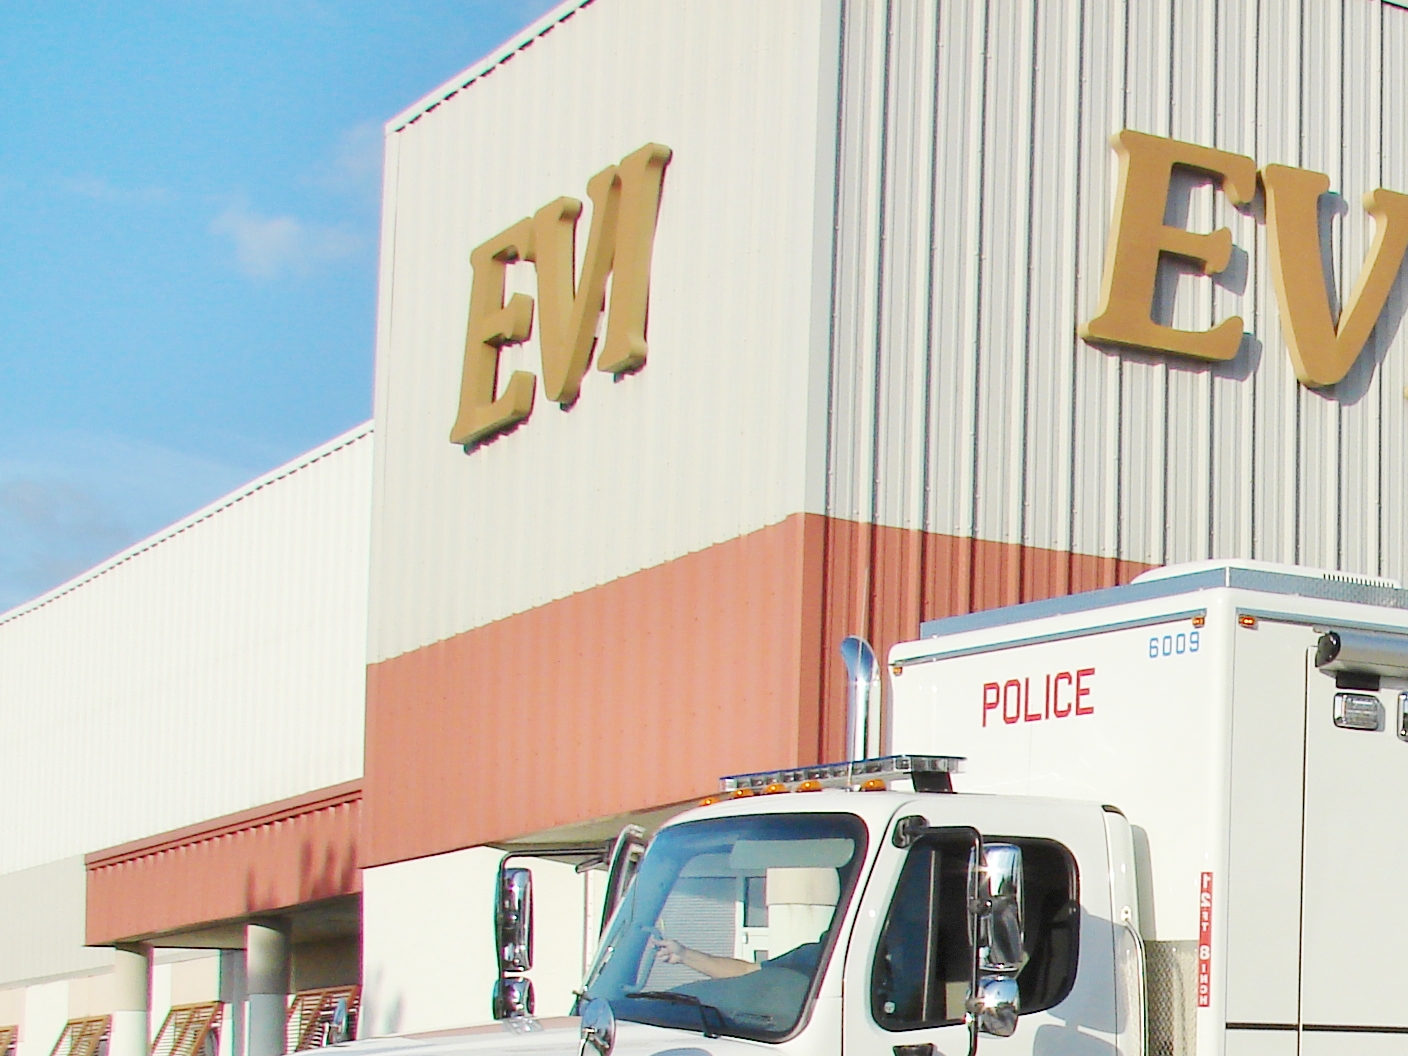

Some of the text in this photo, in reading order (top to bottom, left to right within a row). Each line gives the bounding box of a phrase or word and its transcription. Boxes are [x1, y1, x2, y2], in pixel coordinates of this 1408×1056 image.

[450, 142, 673, 444] EVI
[1149, 631, 1200, 658] 6009
[982, 668, 1096, 728] POLICE
